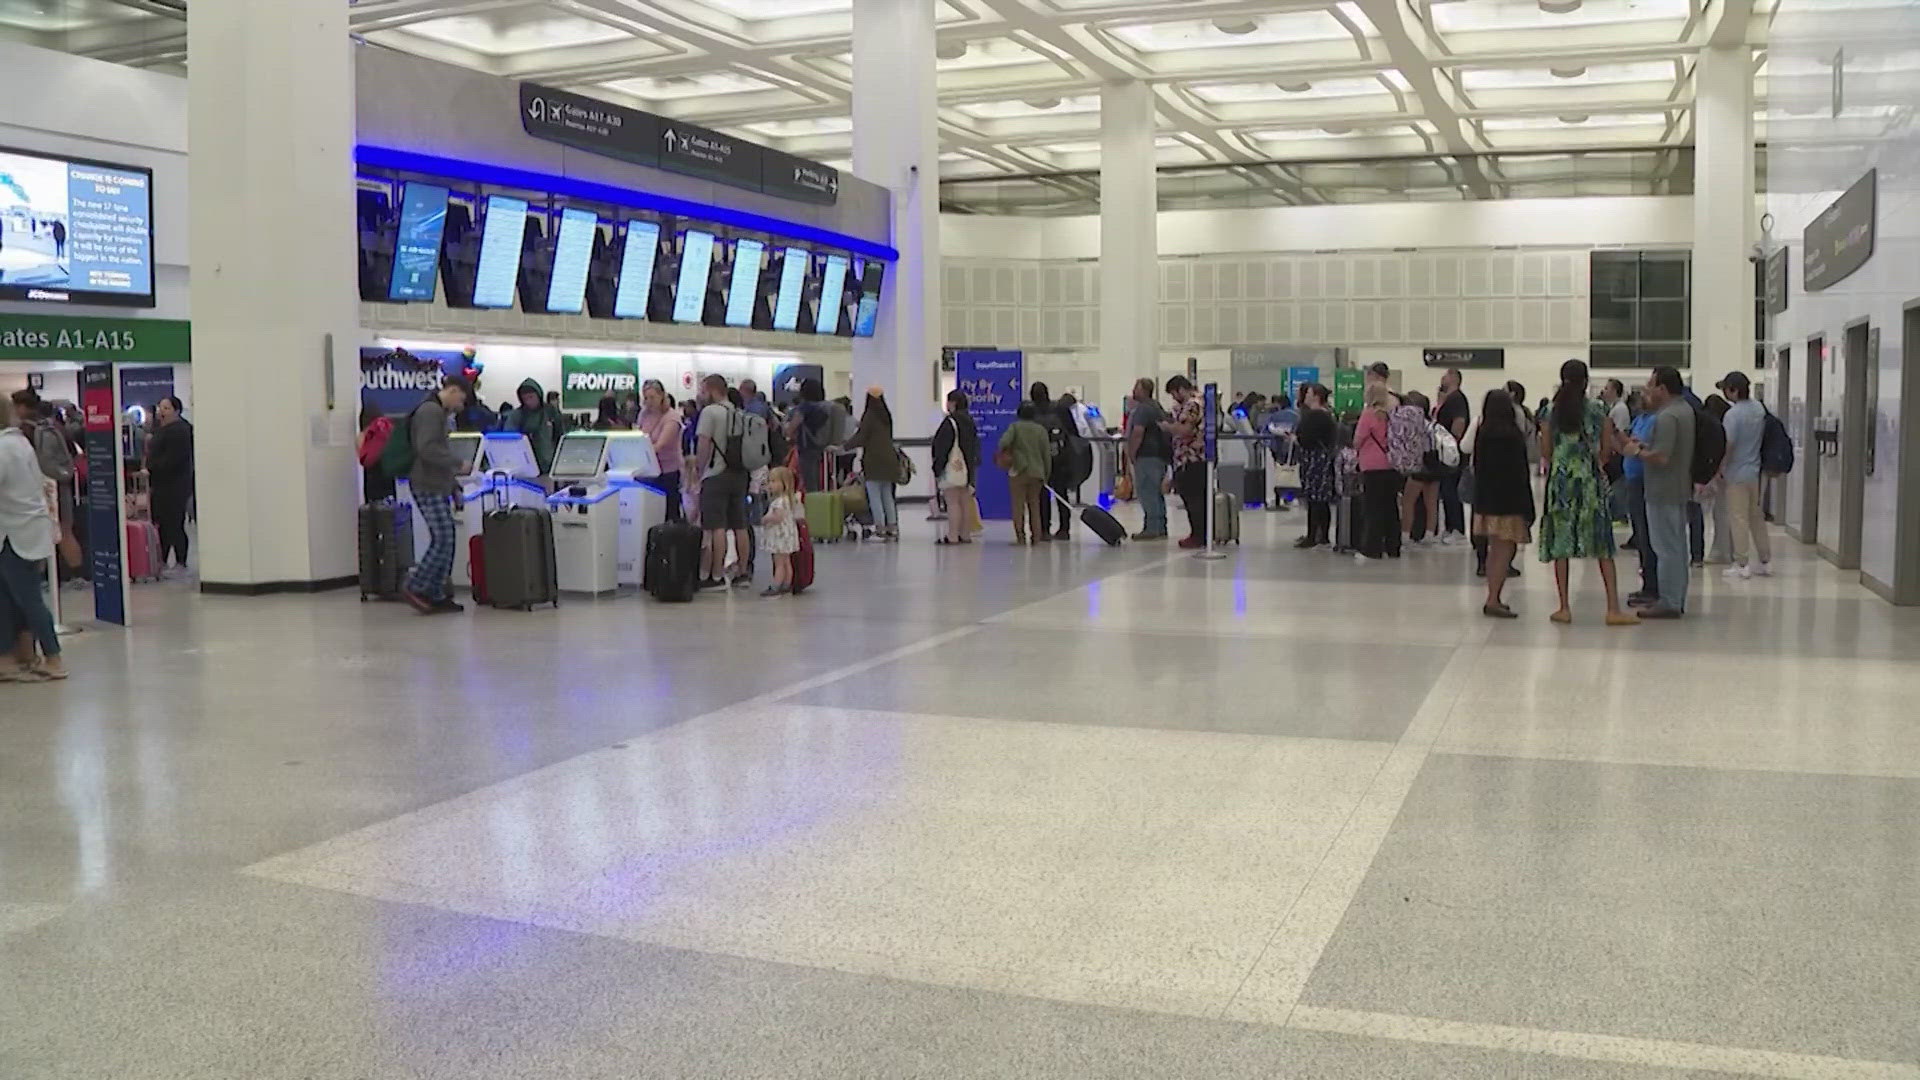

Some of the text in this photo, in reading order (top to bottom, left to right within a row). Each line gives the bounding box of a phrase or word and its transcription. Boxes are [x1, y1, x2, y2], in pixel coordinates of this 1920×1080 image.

[112, 175, 145, 188] COMING
[95, 184, 106, 193] TO
[72, 197, 86, 207] The
[88, 201, 102, 209] new
[80, 242, 92, 250] will
[93, 244, 103, 252] be
[118, 245, 126, 254] of
[127, 246, 138, 254] the
[101, 254, 107, 262] in
[109, 254, 120, 263] the
[0, 328, 135, 350] ates A1-A15
[567, 373, 636, 390] FRONTIER
